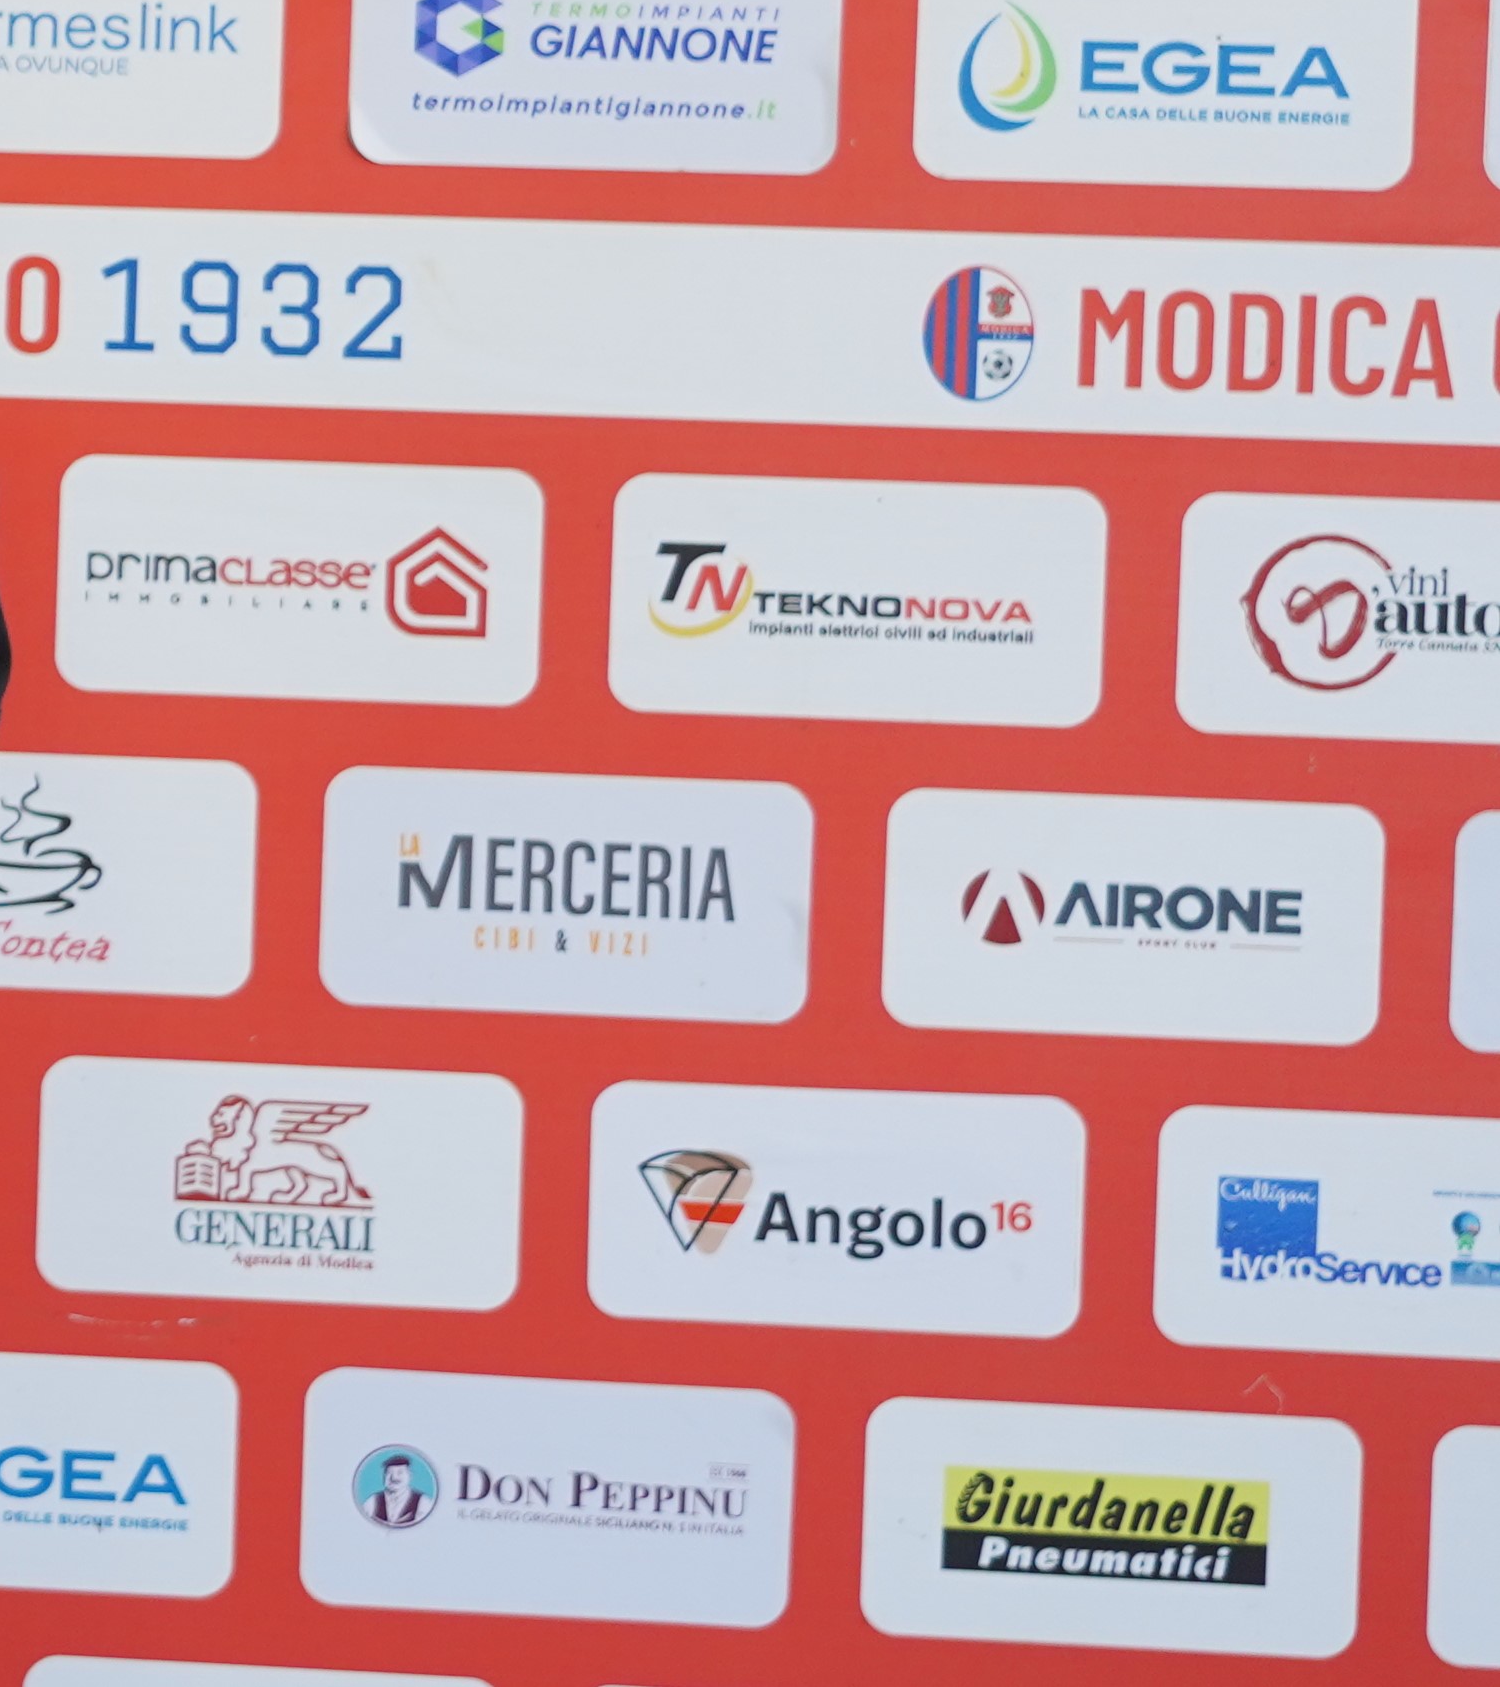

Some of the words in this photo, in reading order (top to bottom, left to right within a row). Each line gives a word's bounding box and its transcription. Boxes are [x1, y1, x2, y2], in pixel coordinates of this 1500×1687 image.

[529, 23, 779, 64] GIANNONE
[14, 53, 130, 79] OVUNQUE
[1080, 40, 1350, 100] EGEA
[1078, 106, 1100, 119] LA
[1104, 105, 1151, 120] CASA
[1155, 107, 1209, 123] DELLE
[1212, 108, 1273, 124] BUONE
[1277, 110, 1351, 126] ENERGIE
[101, 257, 403, 361] 1932
[1077, 287, 1455, 400] MODICA
[1388, 565, 1449, 596] vini
[751, 588, 1032, 623] TEKNONOVA
[396, 834, 737, 924] MERCERIA
[473, 924, 535, 951] CIBI
[588, 930, 648, 957] VIZI
[174, 1208, 374, 1253] GENERALI
[2, 1509, 54, 1526] DELLE
[118, 1515, 189, 1533] ENERGIE
[953, 1471, 1256, 1544] Giurdanella
[977, 1538, 1231, 1582] Pneumatici
